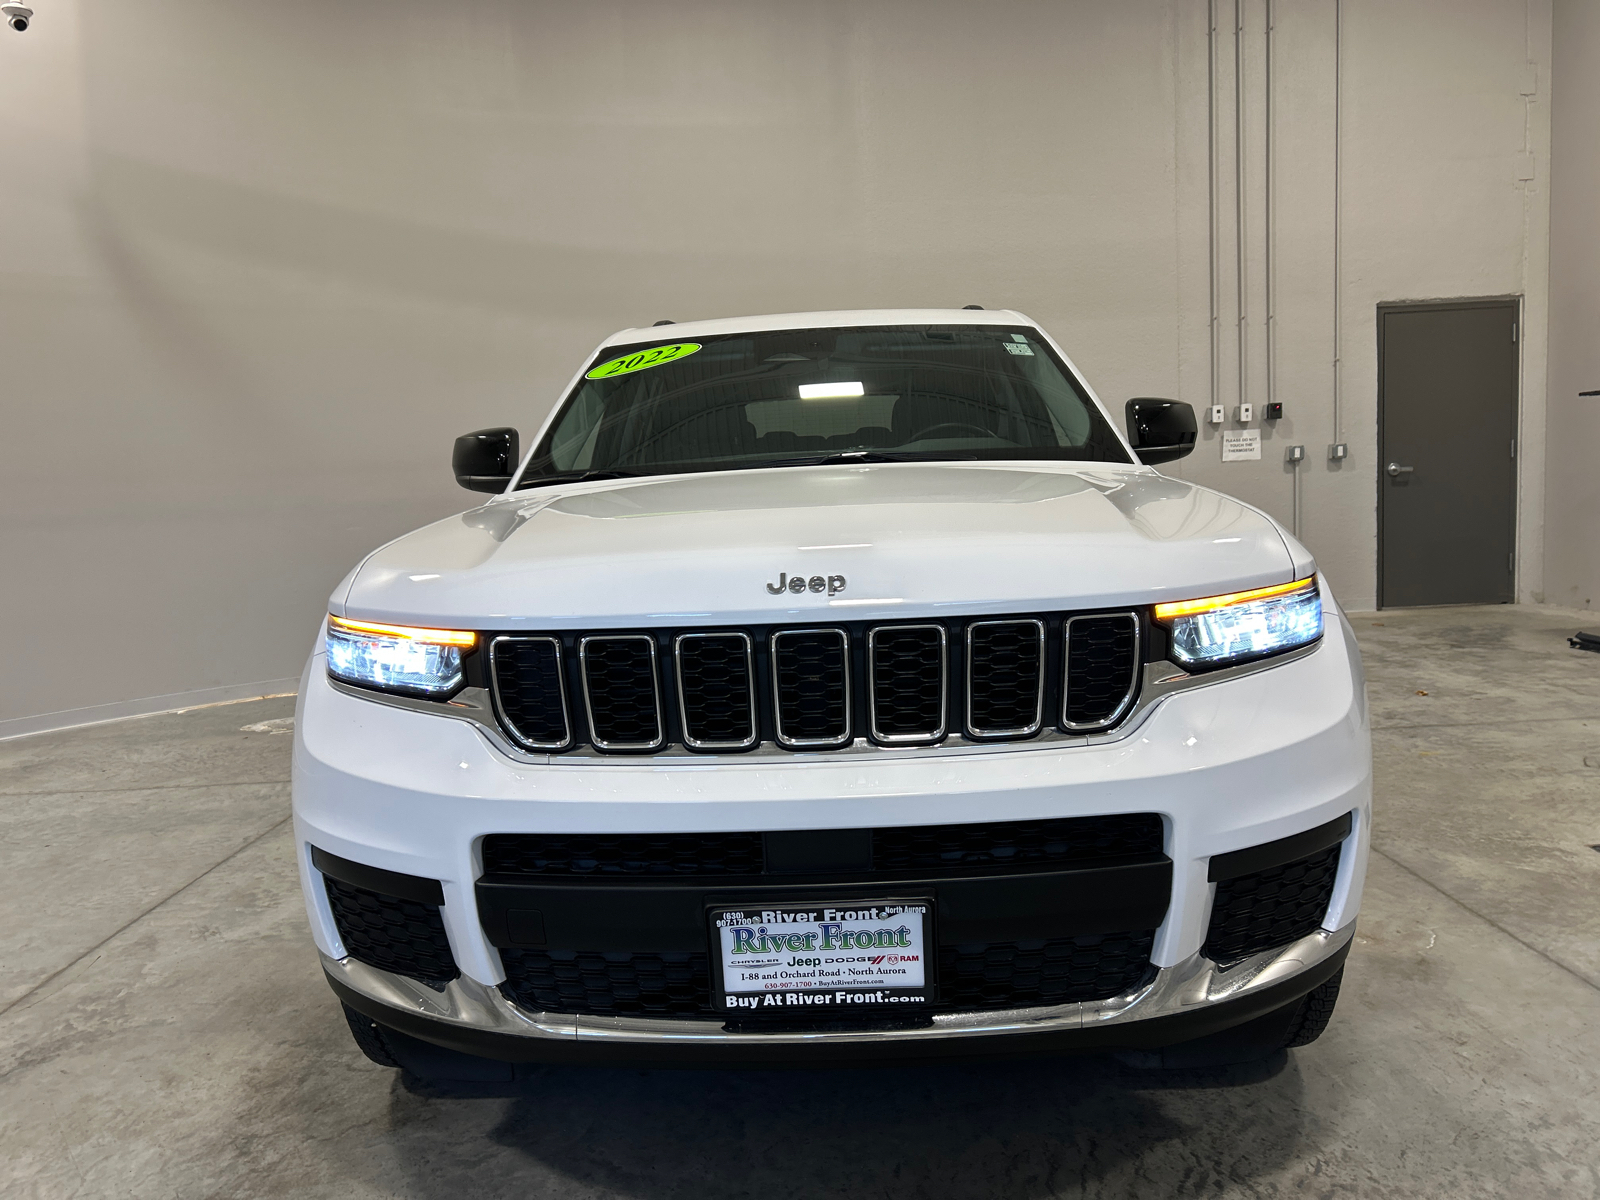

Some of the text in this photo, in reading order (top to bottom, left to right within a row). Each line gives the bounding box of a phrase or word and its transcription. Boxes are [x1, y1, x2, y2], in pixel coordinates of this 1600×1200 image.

[605, 346, 682, 376] 2022
[766, 572, 847, 597] Jeep
[722, 911, 744, 920] (630)
[761, 907, 879, 924] River Front
[884, 905, 926, 914] North Aurora
[716, 917, 752, 928] 907-1700
[730, 921, 912, 955] River Front
[787, 956, 821, 967] Jeep
[824, 956, 877, 964] DODGE
[741, 967, 907, 981] I-88 and Orchard Road North Aurora
[764, 979, 884, 989] 630-907-1700 BuyAtRiverFront.com
[725, 995, 759, 1009] Buy
[763, 993, 782, 1006] At
[785, 992, 832, 1006] River
